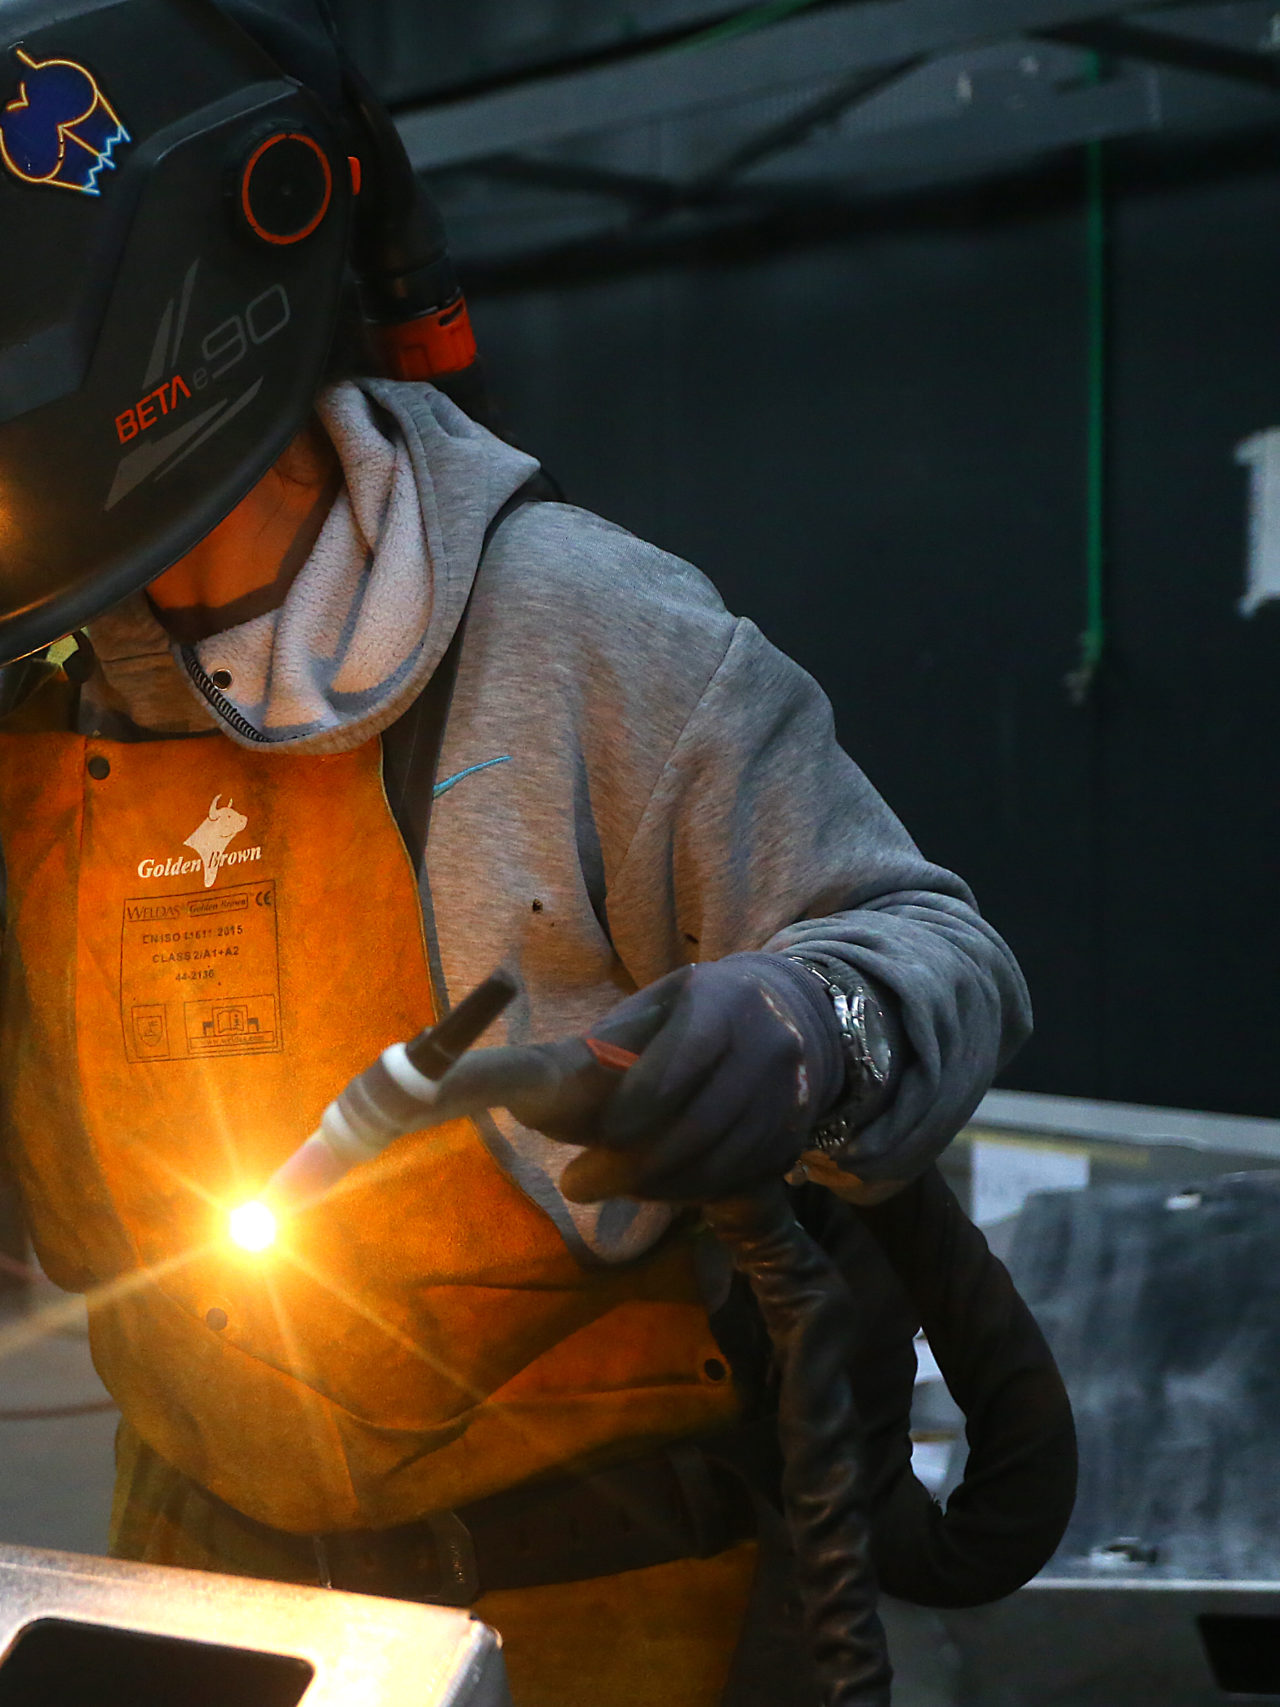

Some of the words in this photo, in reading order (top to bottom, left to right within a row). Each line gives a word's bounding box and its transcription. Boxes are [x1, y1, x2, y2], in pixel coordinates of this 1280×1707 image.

[115, 375, 191, 444] BETA
[137, 856, 202, 879] Golden
[207, 846, 263, 869] Brown
[217, 925, 243, 937] 2015
[153, 951, 191, 963] CLASS
